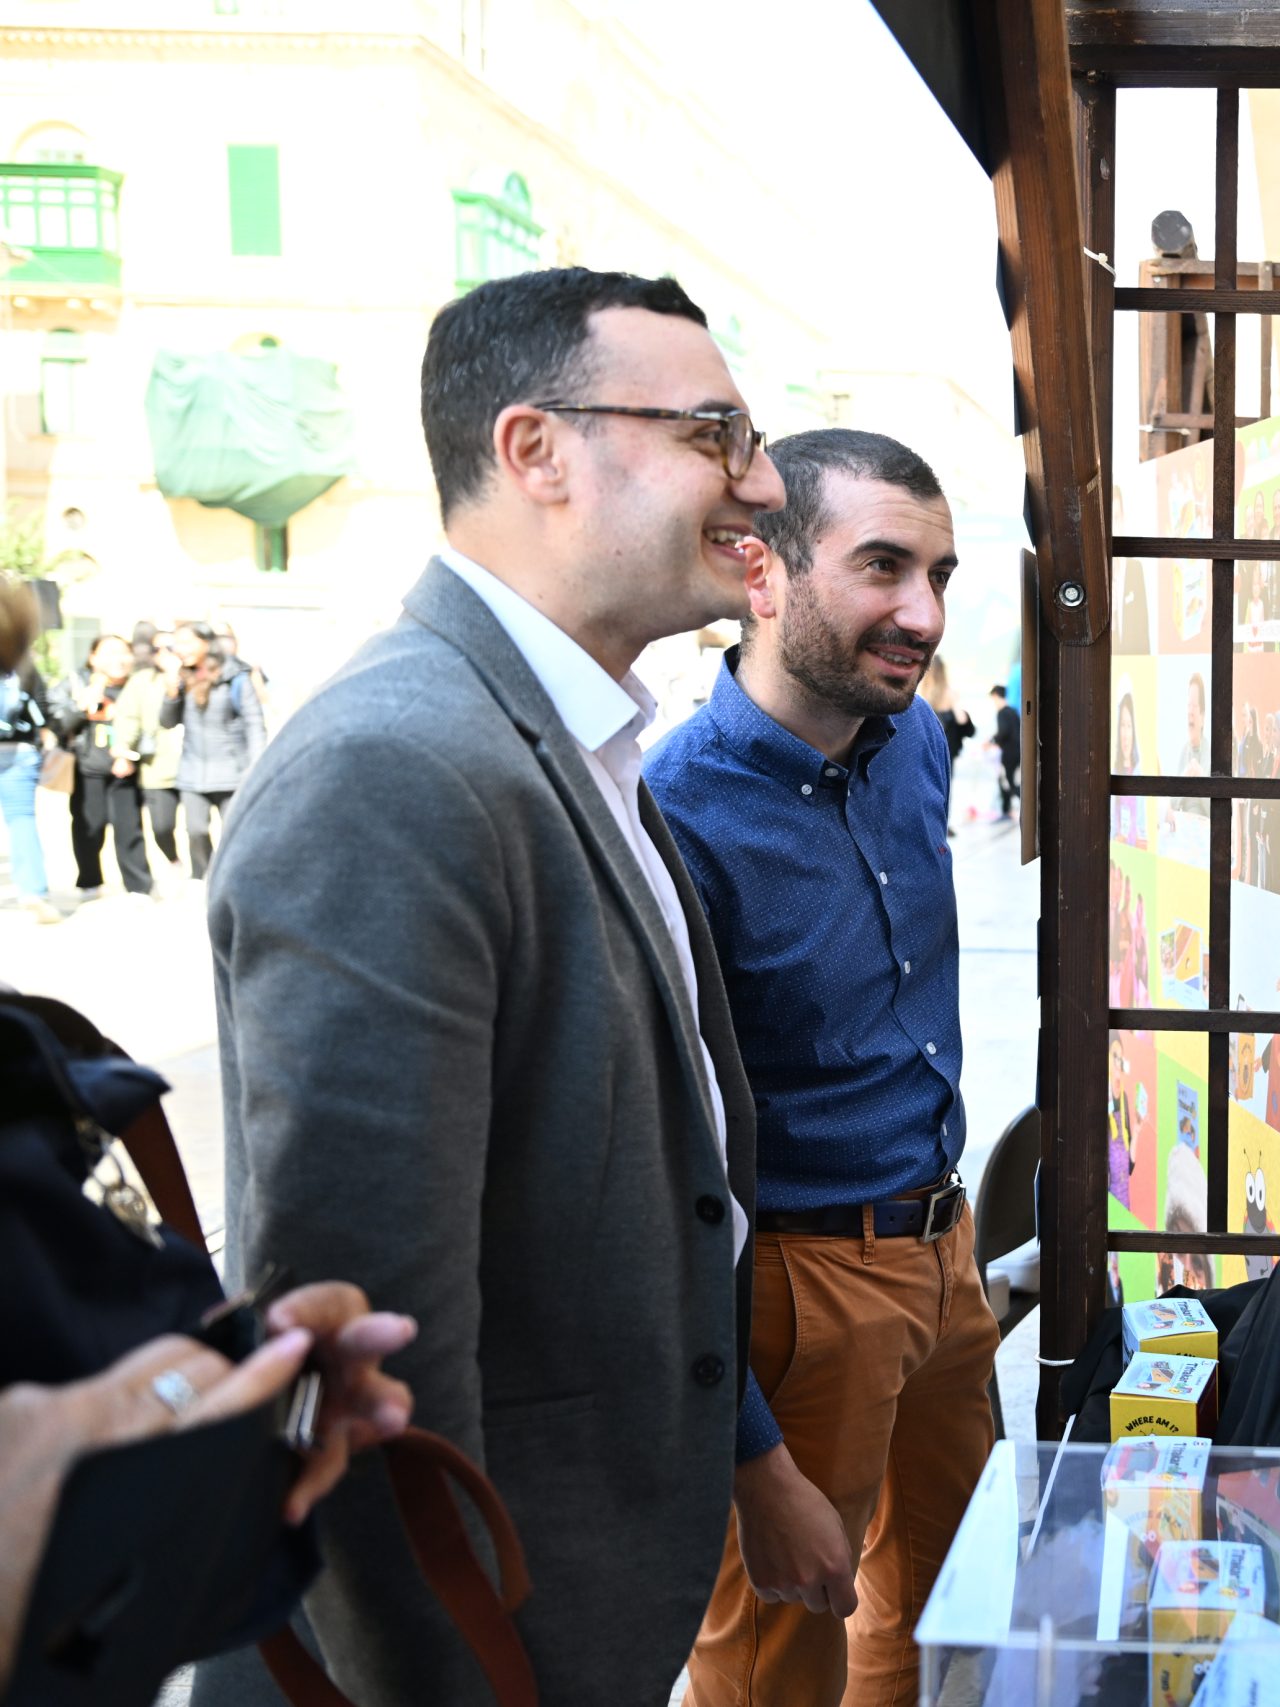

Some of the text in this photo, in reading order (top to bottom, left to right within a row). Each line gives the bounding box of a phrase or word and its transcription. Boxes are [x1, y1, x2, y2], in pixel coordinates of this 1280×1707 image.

[1125, 1416, 1180, 1434] WHERE AM I?
